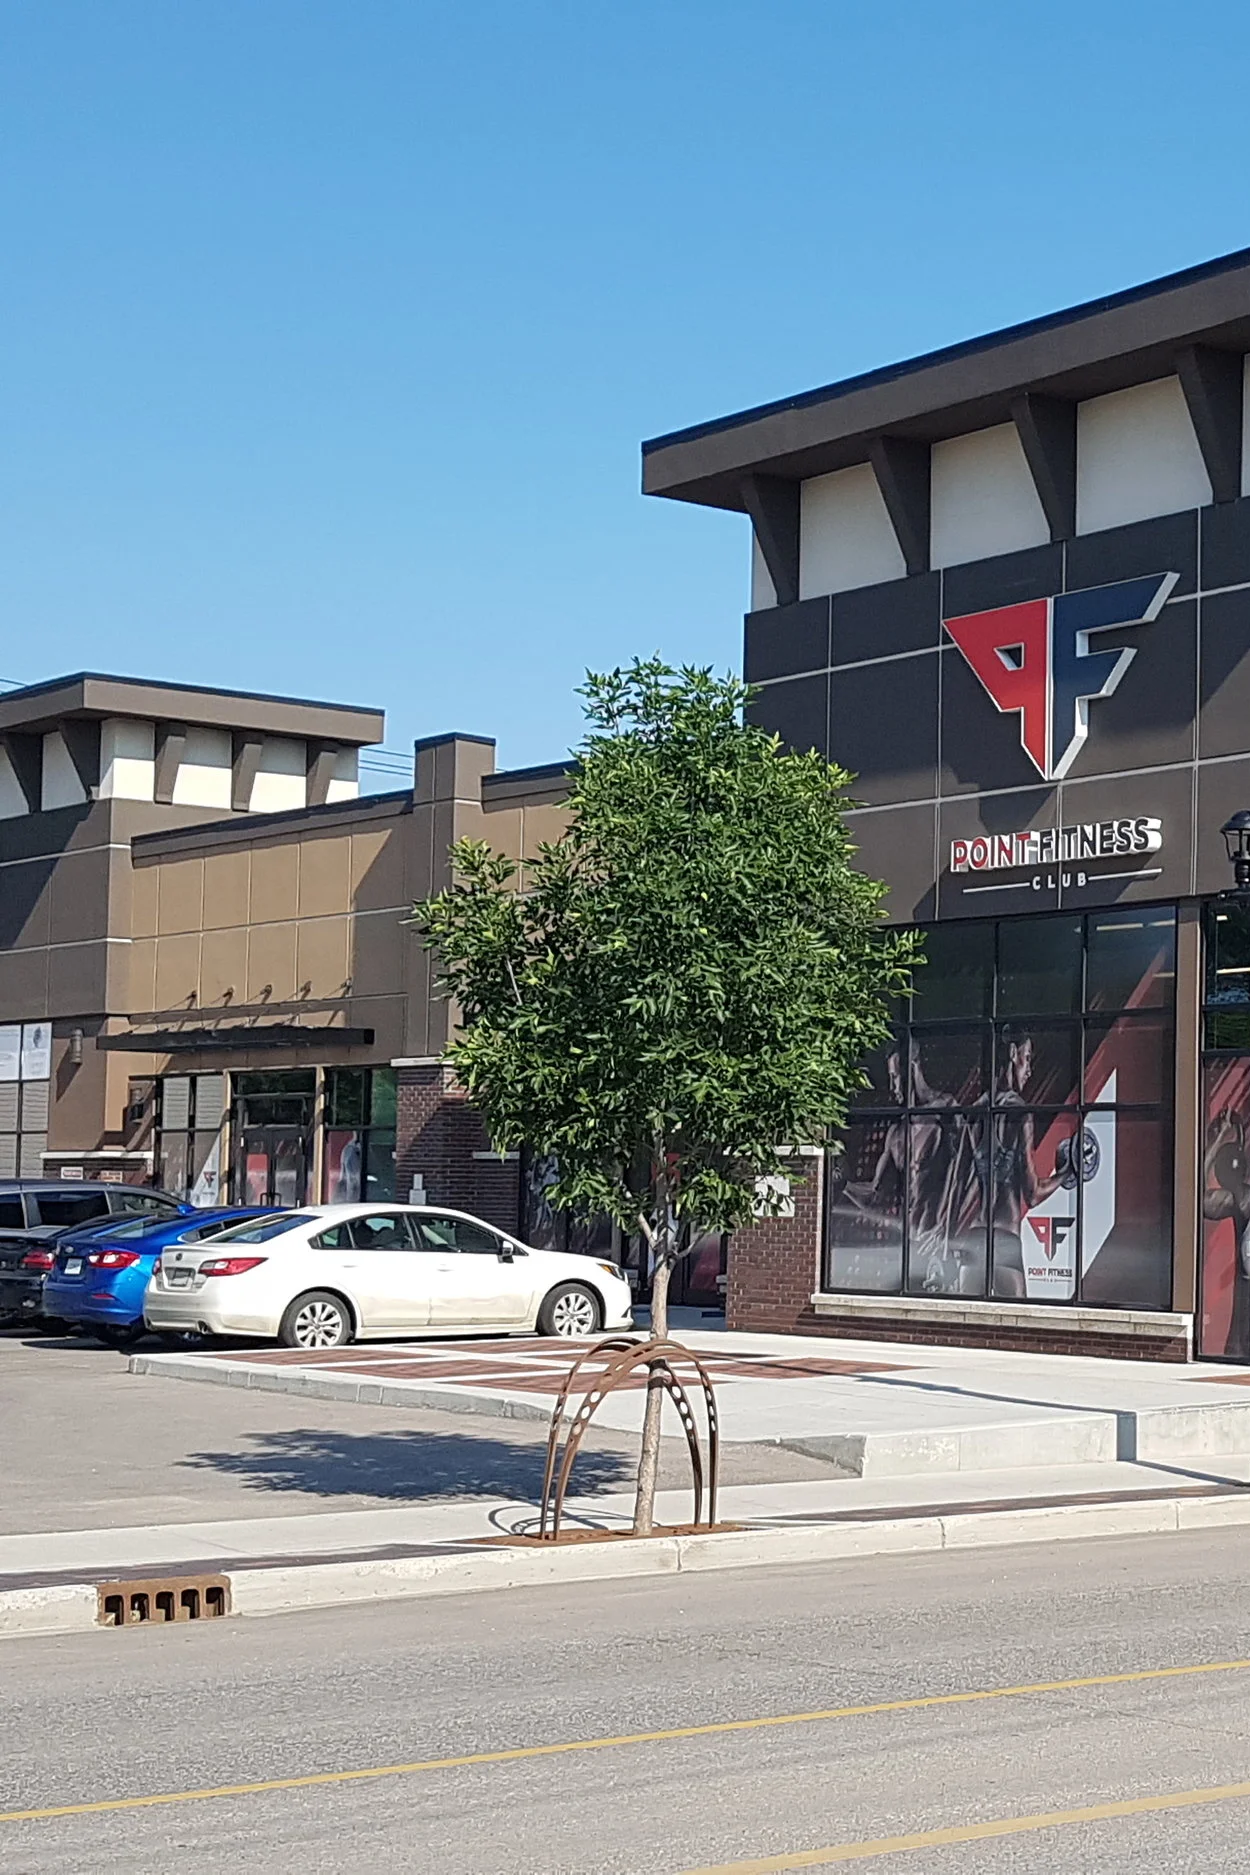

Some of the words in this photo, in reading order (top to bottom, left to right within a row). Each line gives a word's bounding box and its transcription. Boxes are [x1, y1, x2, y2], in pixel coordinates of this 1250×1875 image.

[951, 833, 1033, 872] POINT
[1038, 817, 1162, 863] FITNESS
[1032, 872, 1087, 890] CLUB
[1028, 1267, 1046, 1276] POINT
